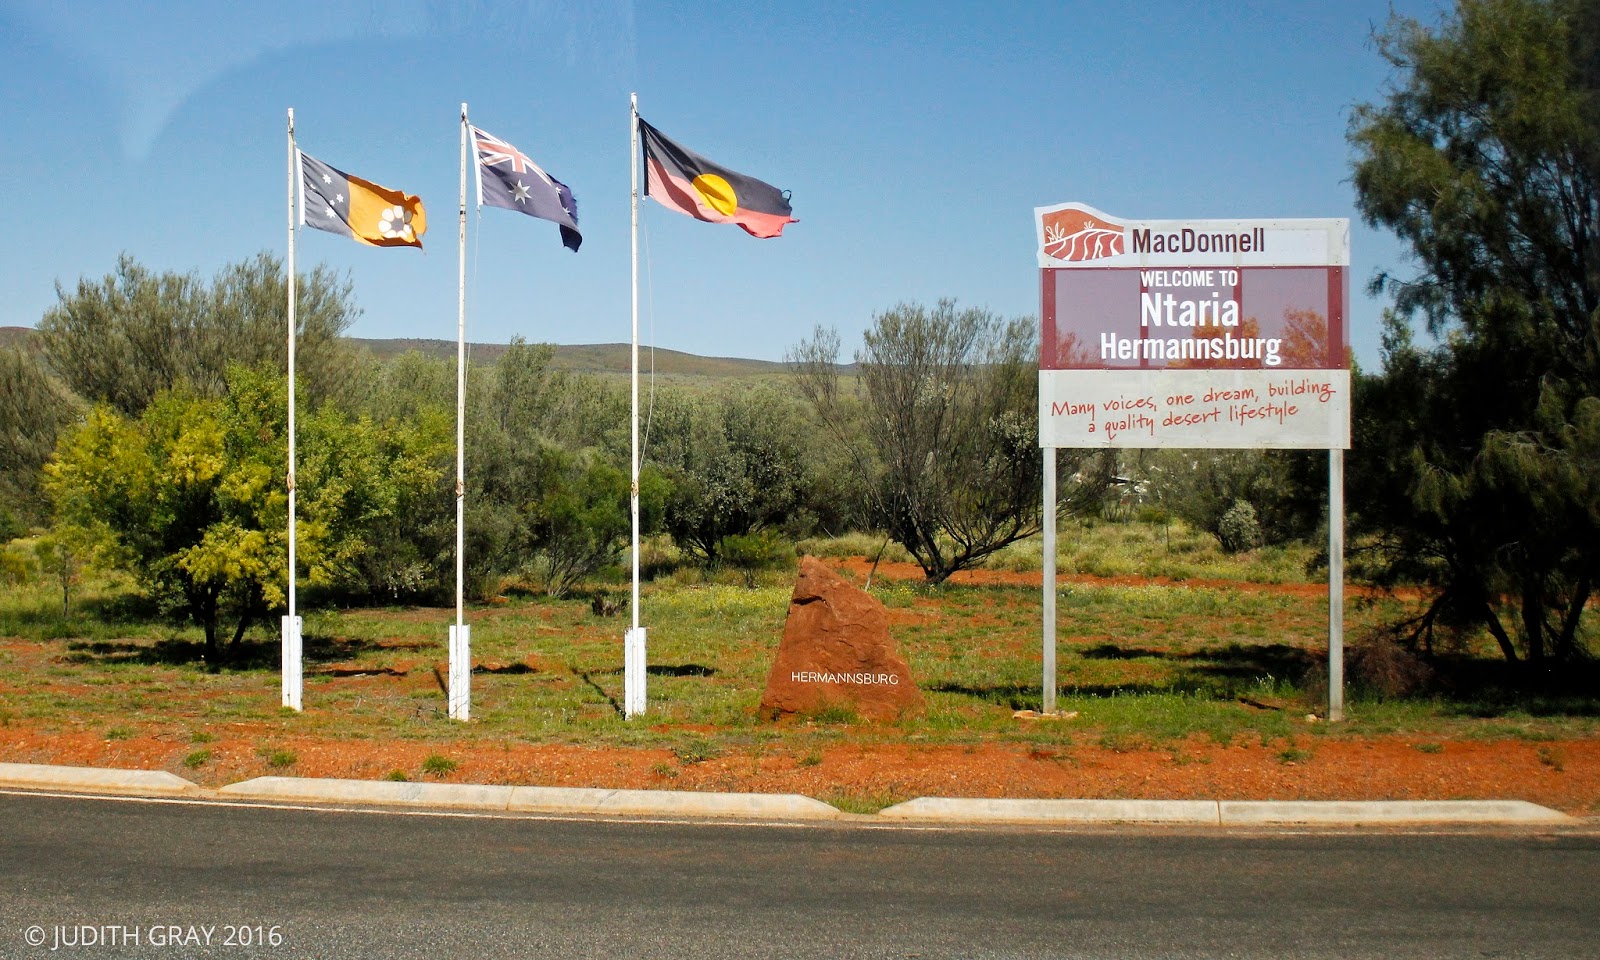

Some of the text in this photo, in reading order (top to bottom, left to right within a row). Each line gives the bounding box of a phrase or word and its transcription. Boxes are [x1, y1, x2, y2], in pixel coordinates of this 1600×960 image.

[1132, 227, 1265, 253] MacDonnell
[1140, 270, 1239, 288] WELCOME TO
[1140, 292, 1240, 327] Ntaria
[1100, 332, 1282, 365] Hermannsburg
[1051, 379, 1337, 421] Many voices, one dream, building
[1088, 402, 1299, 440] a quality desert lifestyle
[790, 671, 899, 685] HERMANNSBURG
